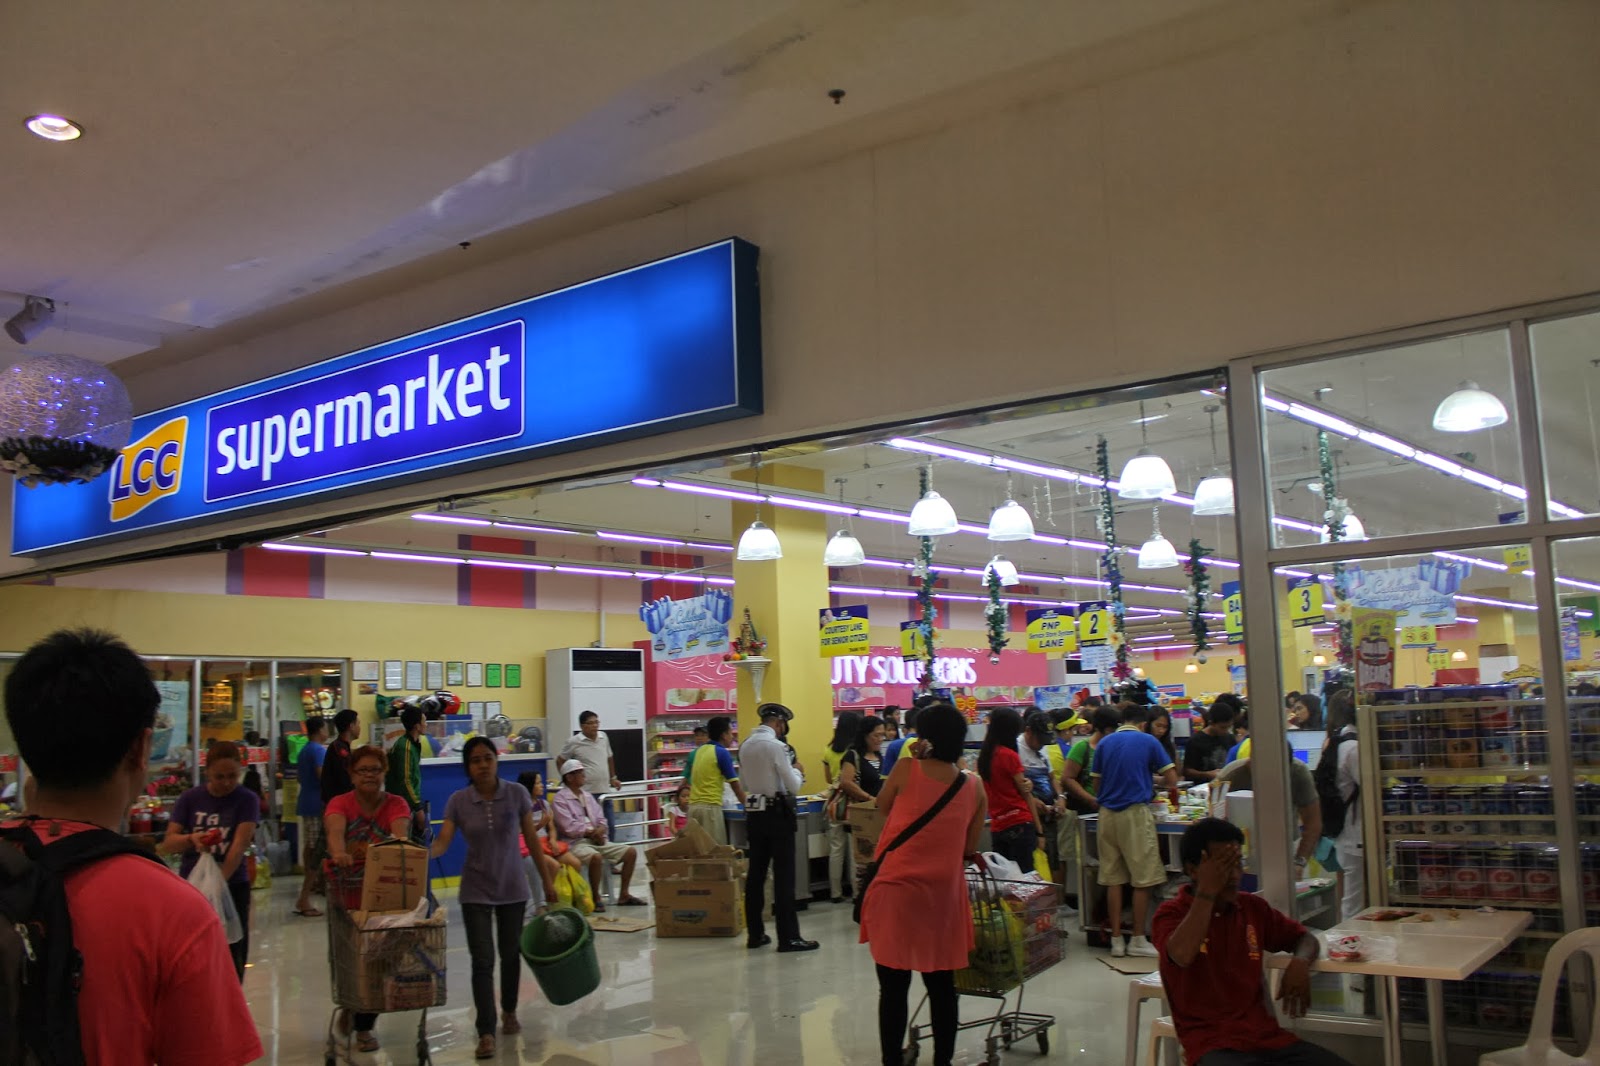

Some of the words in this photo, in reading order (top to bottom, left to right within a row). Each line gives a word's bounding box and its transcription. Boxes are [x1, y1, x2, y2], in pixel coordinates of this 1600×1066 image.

[109, 440, 180, 503] LCC
[215, 345, 511, 481] supermarket
[1301, 589, 1310, 612] 3
[825, 625, 849, 635] COURTESY
[850, 622, 863, 632] LANE
[1041, 621, 1060, 630] PNP
[1089, 614, 1098, 634] 2
[821, 638, 830, 646] FOR
[831, 636, 849, 645] SENIOR
[849, 633, 868, 643] CITIZEN
[910, 631, 915, 650] 1
[1039, 638, 1064, 648] LANE
